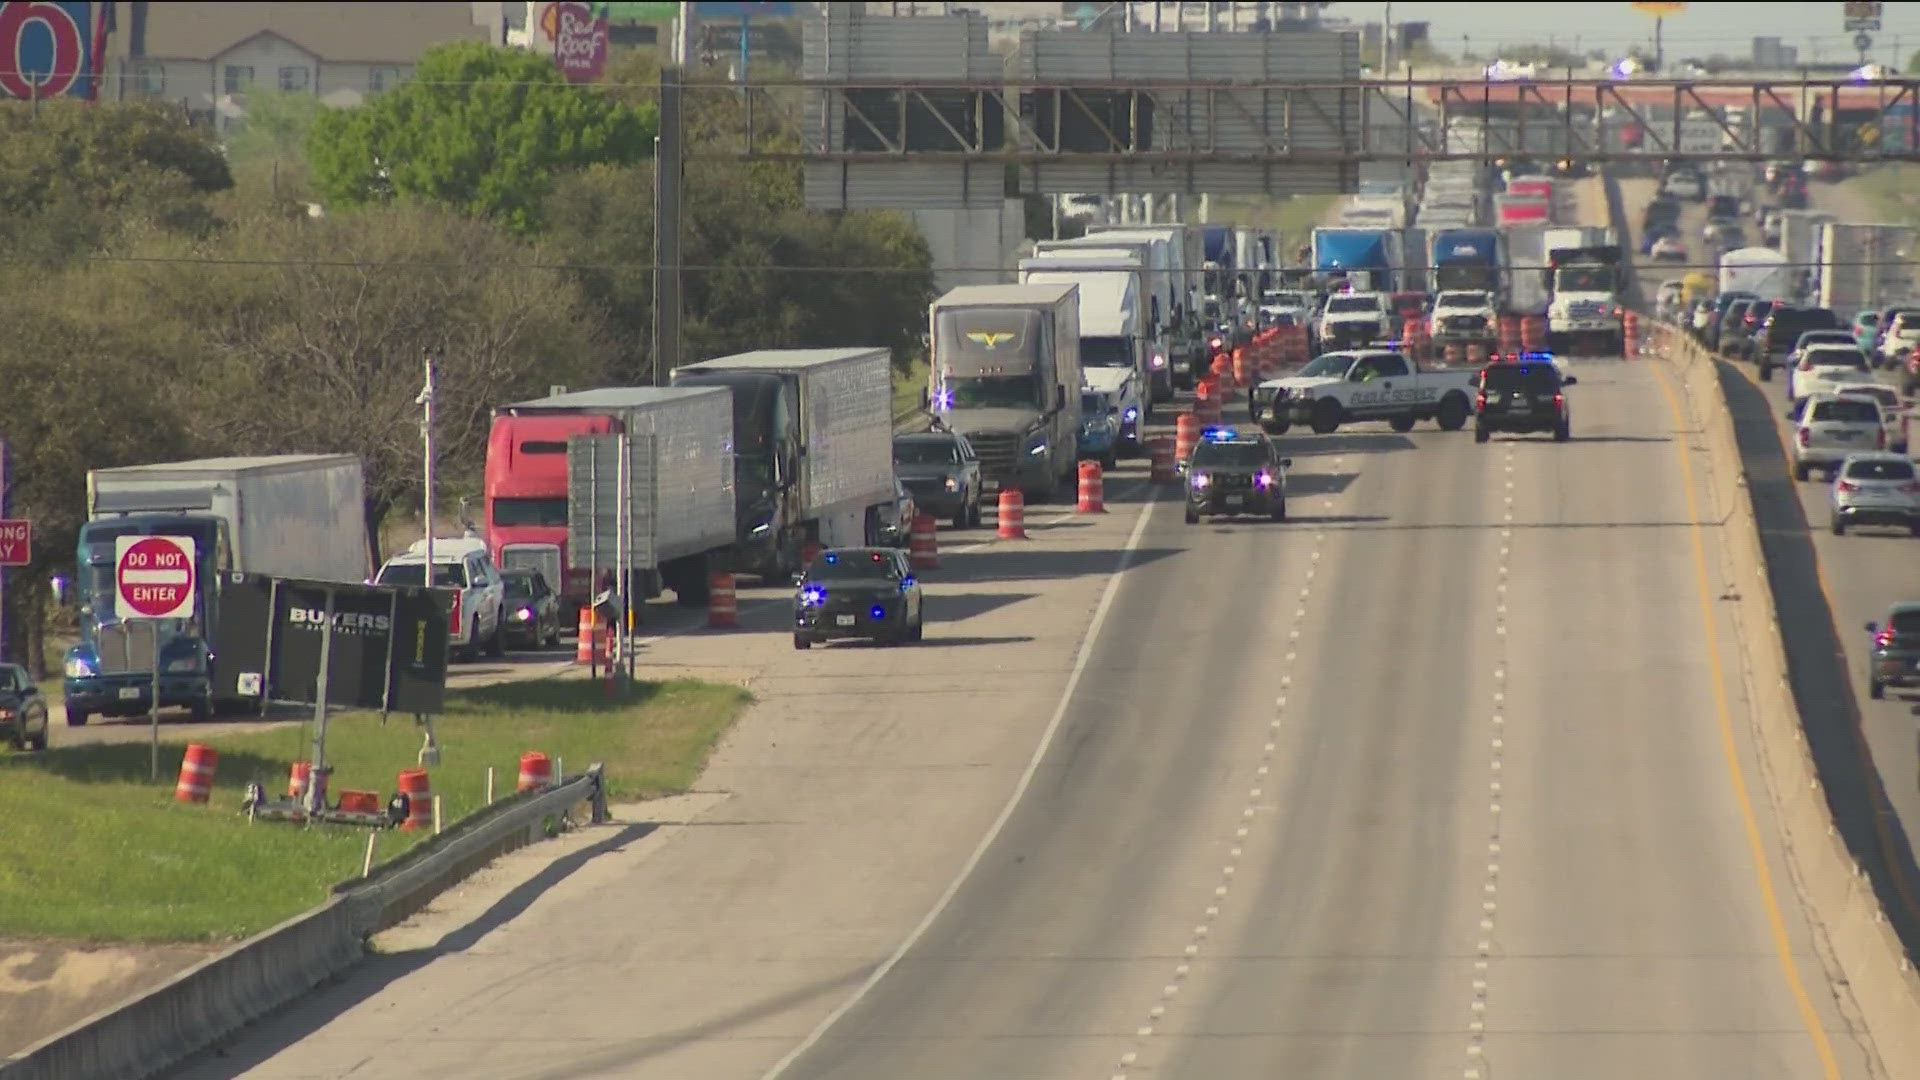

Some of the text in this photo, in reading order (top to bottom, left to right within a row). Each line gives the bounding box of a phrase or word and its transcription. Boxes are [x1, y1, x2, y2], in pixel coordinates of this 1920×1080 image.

[561, 12, 597, 35] Red
[558, 31, 605, 59] Roof
[128, 552, 183, 567] DO NOT
[133, 587, 176, 601] ENTER
